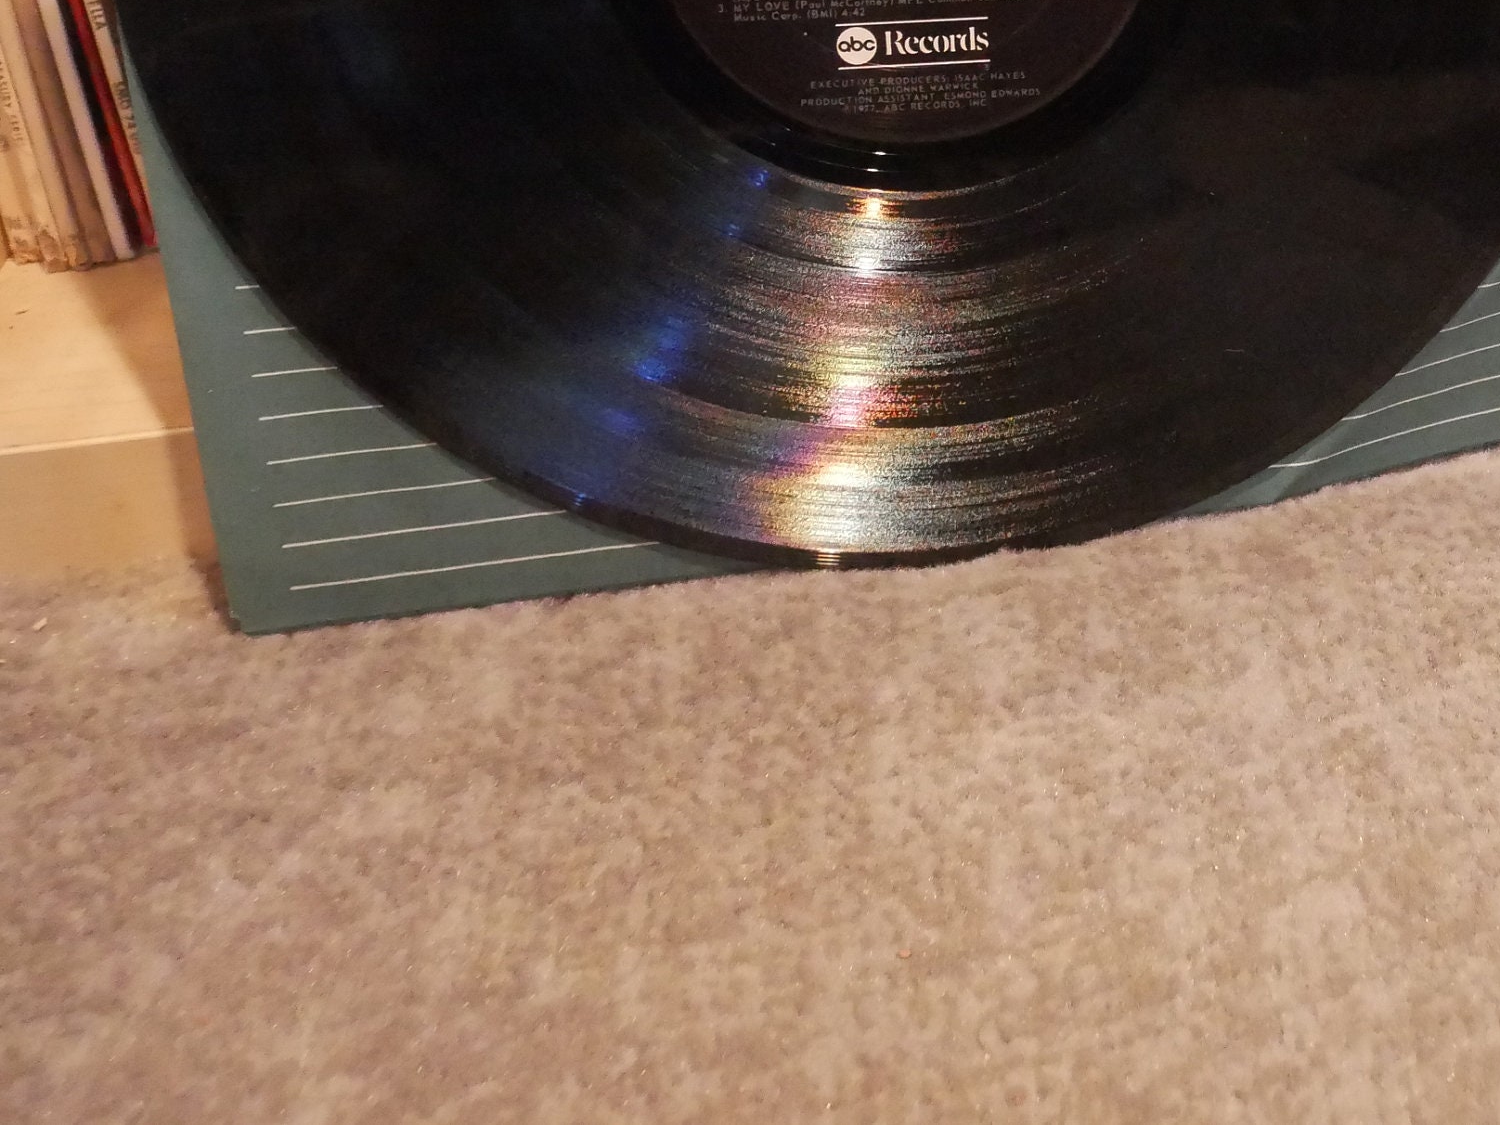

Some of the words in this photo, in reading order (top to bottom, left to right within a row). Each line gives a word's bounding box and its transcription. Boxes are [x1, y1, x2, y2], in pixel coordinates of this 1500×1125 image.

[734, 3, 750, 13] MY
[756, 1, 790, 11] LOVE
[795, 0, 826, 10] (Paul
[734, 13, 767, 22] Music
[772, 11, 803, 21] Corp.
[807, 10, 838, 20] (BMI)
[841, 9, 866, 17] 4:42
[838, 36, 877, 53] abc
[885, 26, 990, 56] Records
[811, 78, 875, 90] EXECUTIVE
[954, 73, 986, 82] ISAAC
[990, 71, 1026, 80] HAYES
[858, 87, 880, 96] AND
[884, 84, 924, 94] DIONNE
[930, 81, 979, 92] WARWICK
[801, 95, 874, 107] PRODUCTION
[943, 90, 988, 101] ESMOND
[991, 87, 1040, 99] EDWARDS
[884, 103, 906, 112] ABC
